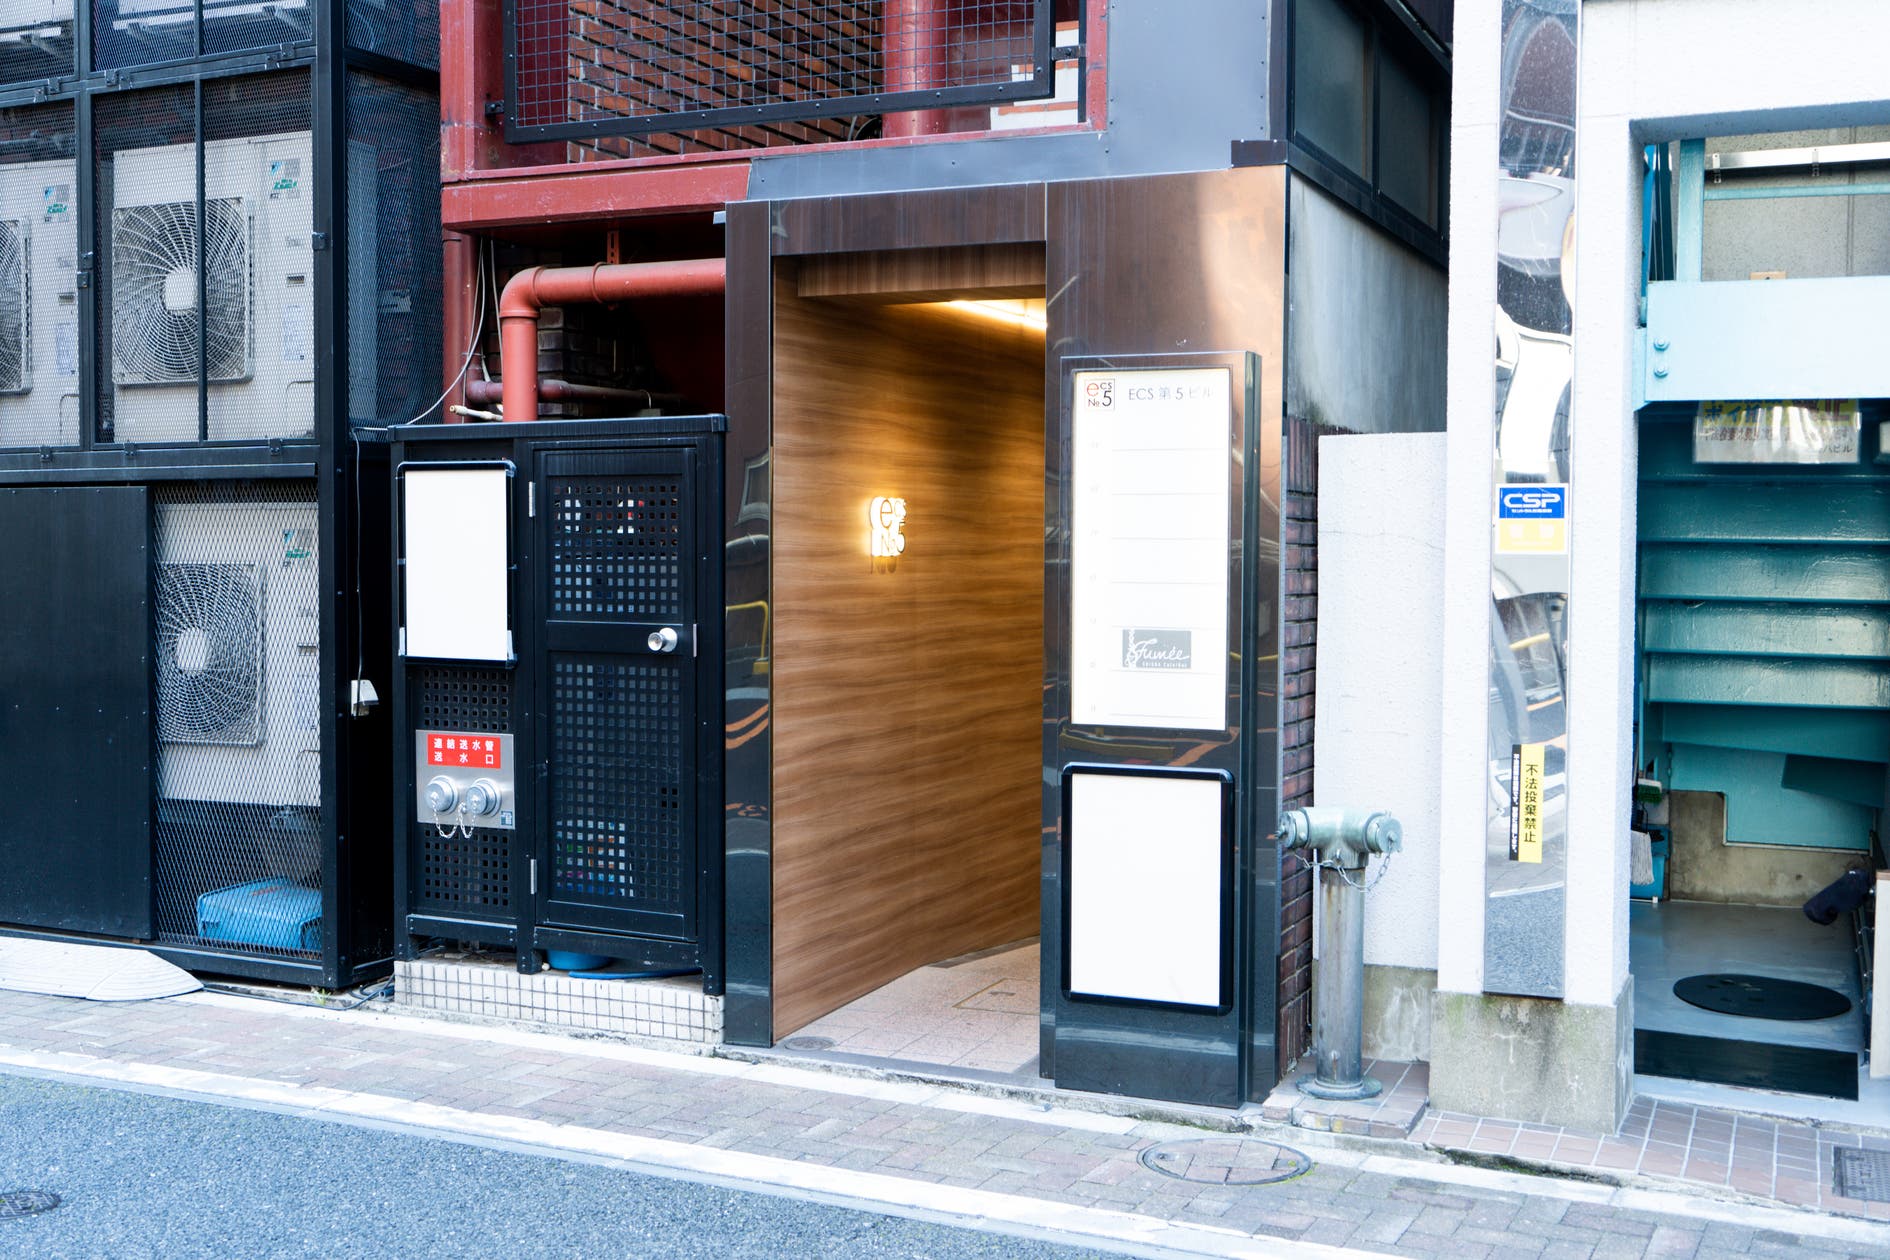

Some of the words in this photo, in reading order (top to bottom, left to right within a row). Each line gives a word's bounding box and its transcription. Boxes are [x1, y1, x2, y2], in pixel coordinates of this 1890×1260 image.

[1128, 387, 1154, 401] ECS
[1503, 493, 1561, 508] CSP
[433, 737, 495, 752] 連結送水管
[434, 751, 495, 765] 送水口
[1524, 764, 1539, 843] 不法投棄禁止
